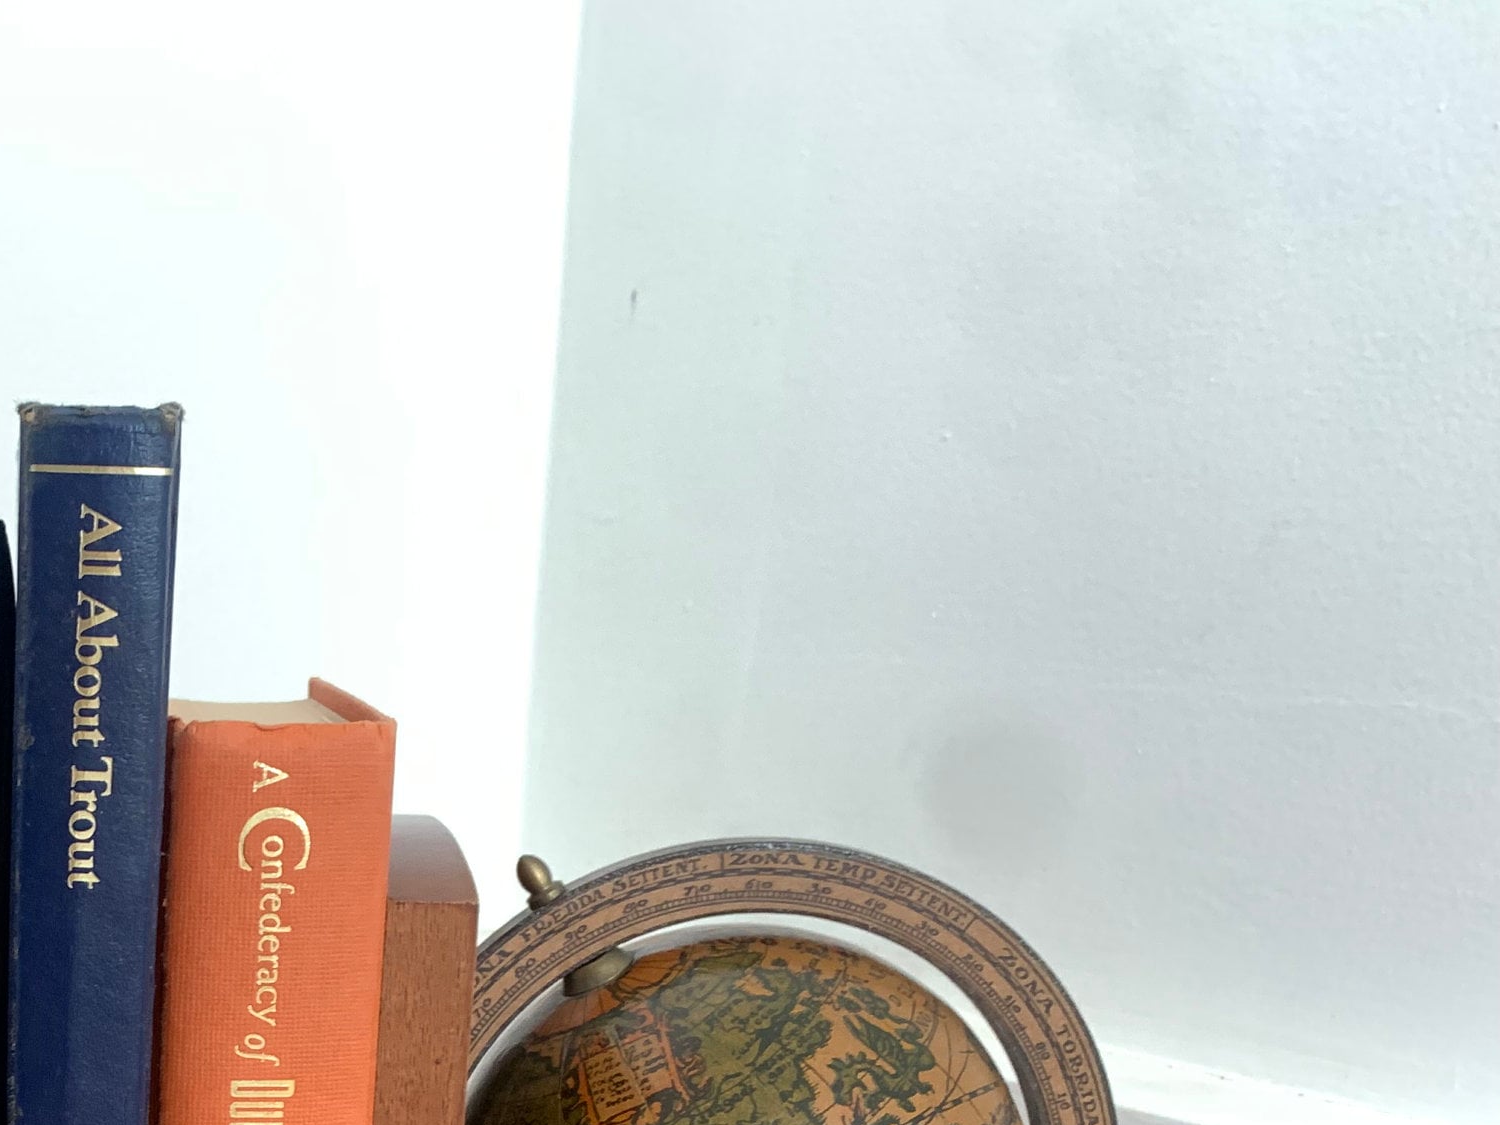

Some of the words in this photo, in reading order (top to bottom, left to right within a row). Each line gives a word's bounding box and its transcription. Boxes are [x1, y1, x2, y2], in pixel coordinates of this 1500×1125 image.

[78, 503, 123, 579] All
[72, 590, 119, 747] About
[252, 760, 290, 793] A
[67, 756, 113, 890] Trout
[729, 853, 805, 866] ZONA
[238, 807, 311, 1027] Confederacy
[519, 892, 607, 943] FREDDA
[998, 947, 1054, 1015] ZONA
[235, 1033, 280, 1067] of
